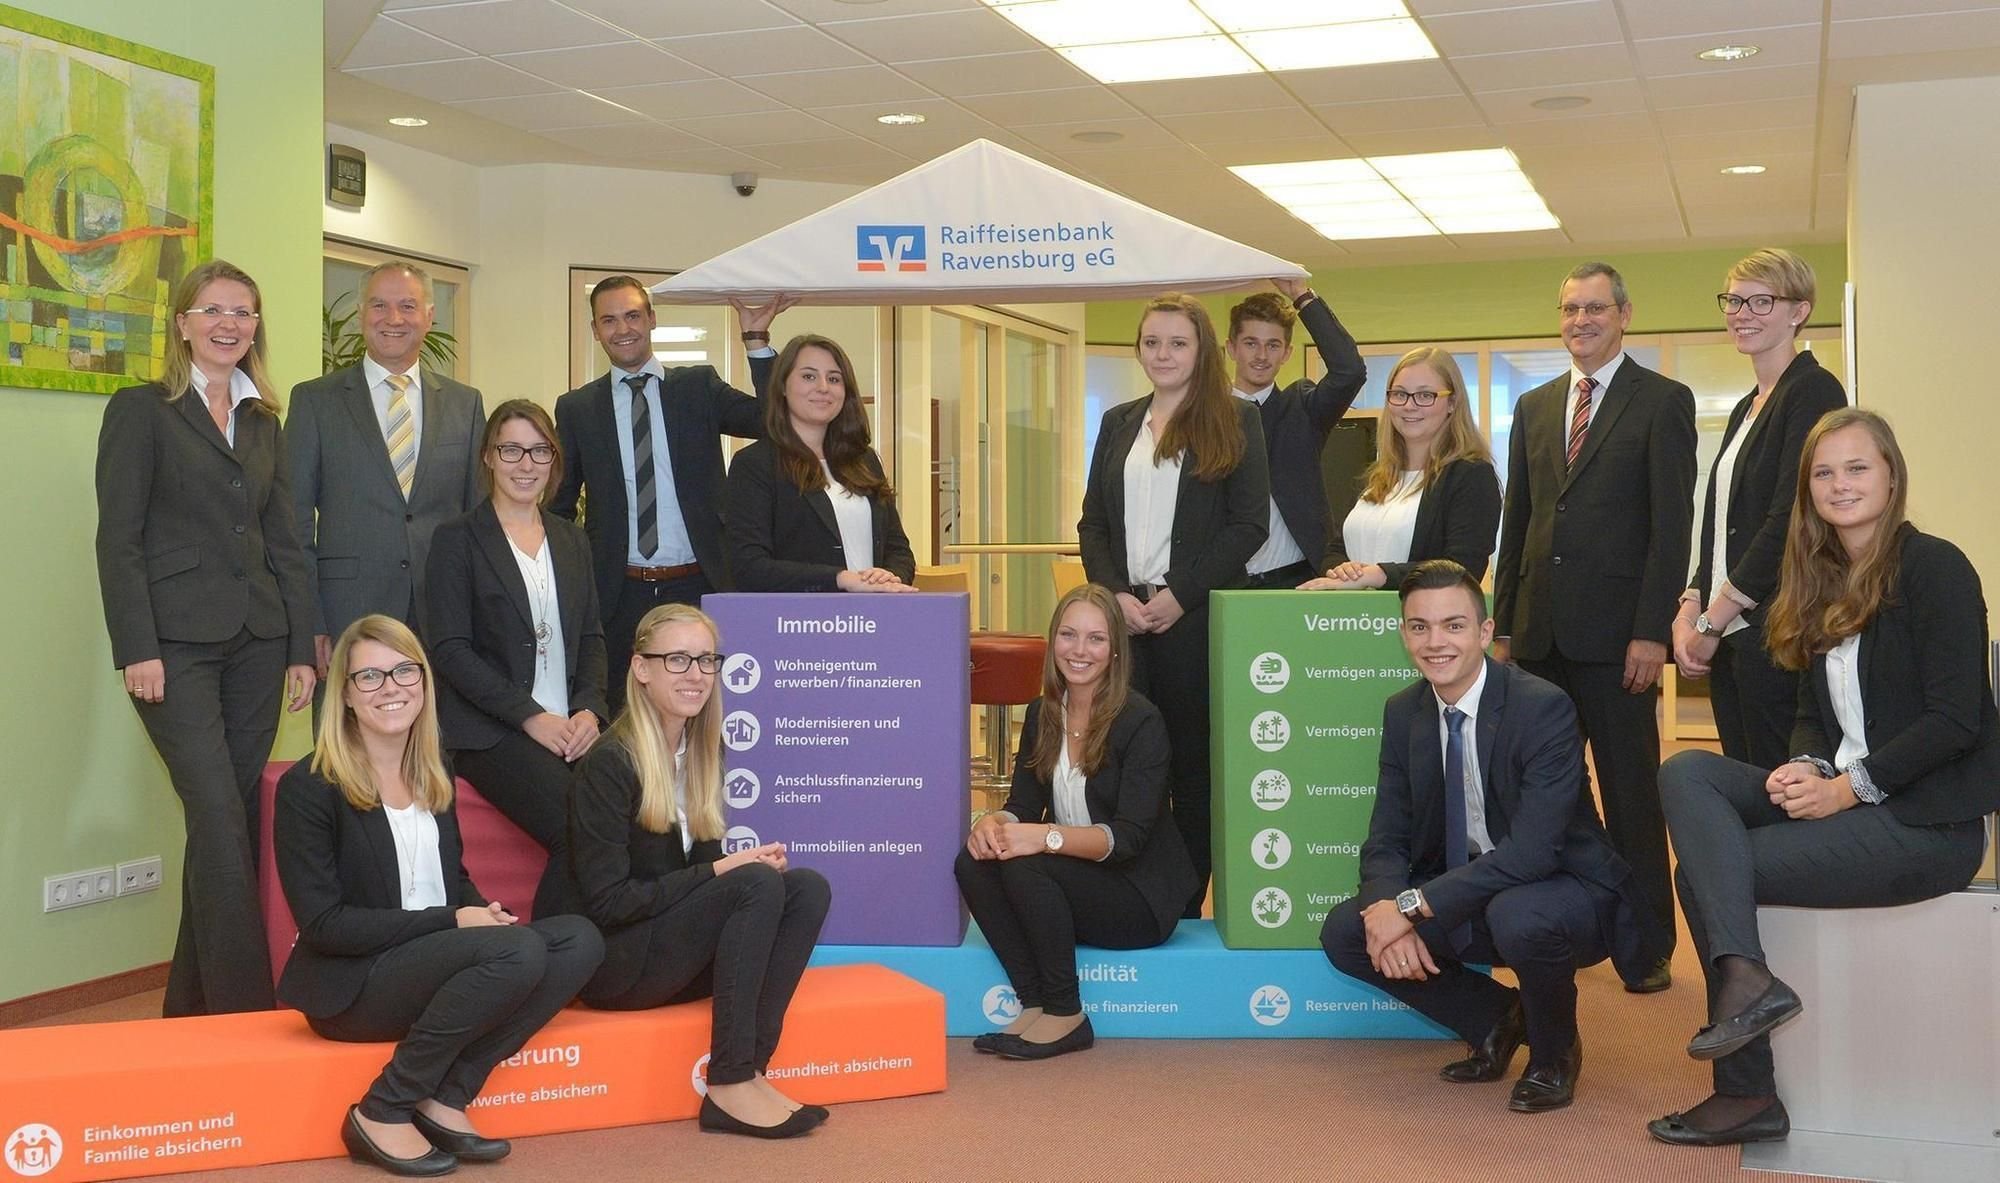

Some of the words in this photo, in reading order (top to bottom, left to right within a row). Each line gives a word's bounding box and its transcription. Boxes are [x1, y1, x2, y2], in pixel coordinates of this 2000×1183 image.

[940, 221, 1115, 245] Raiffeisenbank
[941, 249, 1076, 272] Ravensburg
[1085, 247, 1116, 266] eG
[777, 616, 877, 635] Immobilie
[774, 659, 877, 675] Wohneigentum
[1305, 666, 1375, 681] Vermögen
[775, 716, 871, 730] Modernisieren
[874, 716, 900, 730] und
[775, 733, 849, 747] Renovieren
[1305, 725, 1376, 740] Vermögen
[774, 774, 924, 790] Anschlussfinanzierung
[774, 791, 822, 804] sichern
[1306, 784, 1376, 798] Vermögen
[791, 840, 866, 853] Immobilien
[869, 840, 923, 856] anlegen
[1306, 843, 1360, 856] Vermög
[1307, 892, 1351, 905] Vermö
[1079, 963, 1138, 982] idität
[1102, 1000, 1178, 1013] finanzieren
[1305, 999, 1368, 1012] Reserven
[1372, 998, 1415, 1011] habe
[762, 1061, 839, 1080] esundheit
[843, 1056, 913, 1074] absichern
[530, 1082, 608, 1103] absichern
[83, 1120, 193, 1143] Einkommen
[198, 1111, 235, 1131] und
[83, 1145, 150, 1165] Familie
[154, 1135, 243, 1158] absichern
